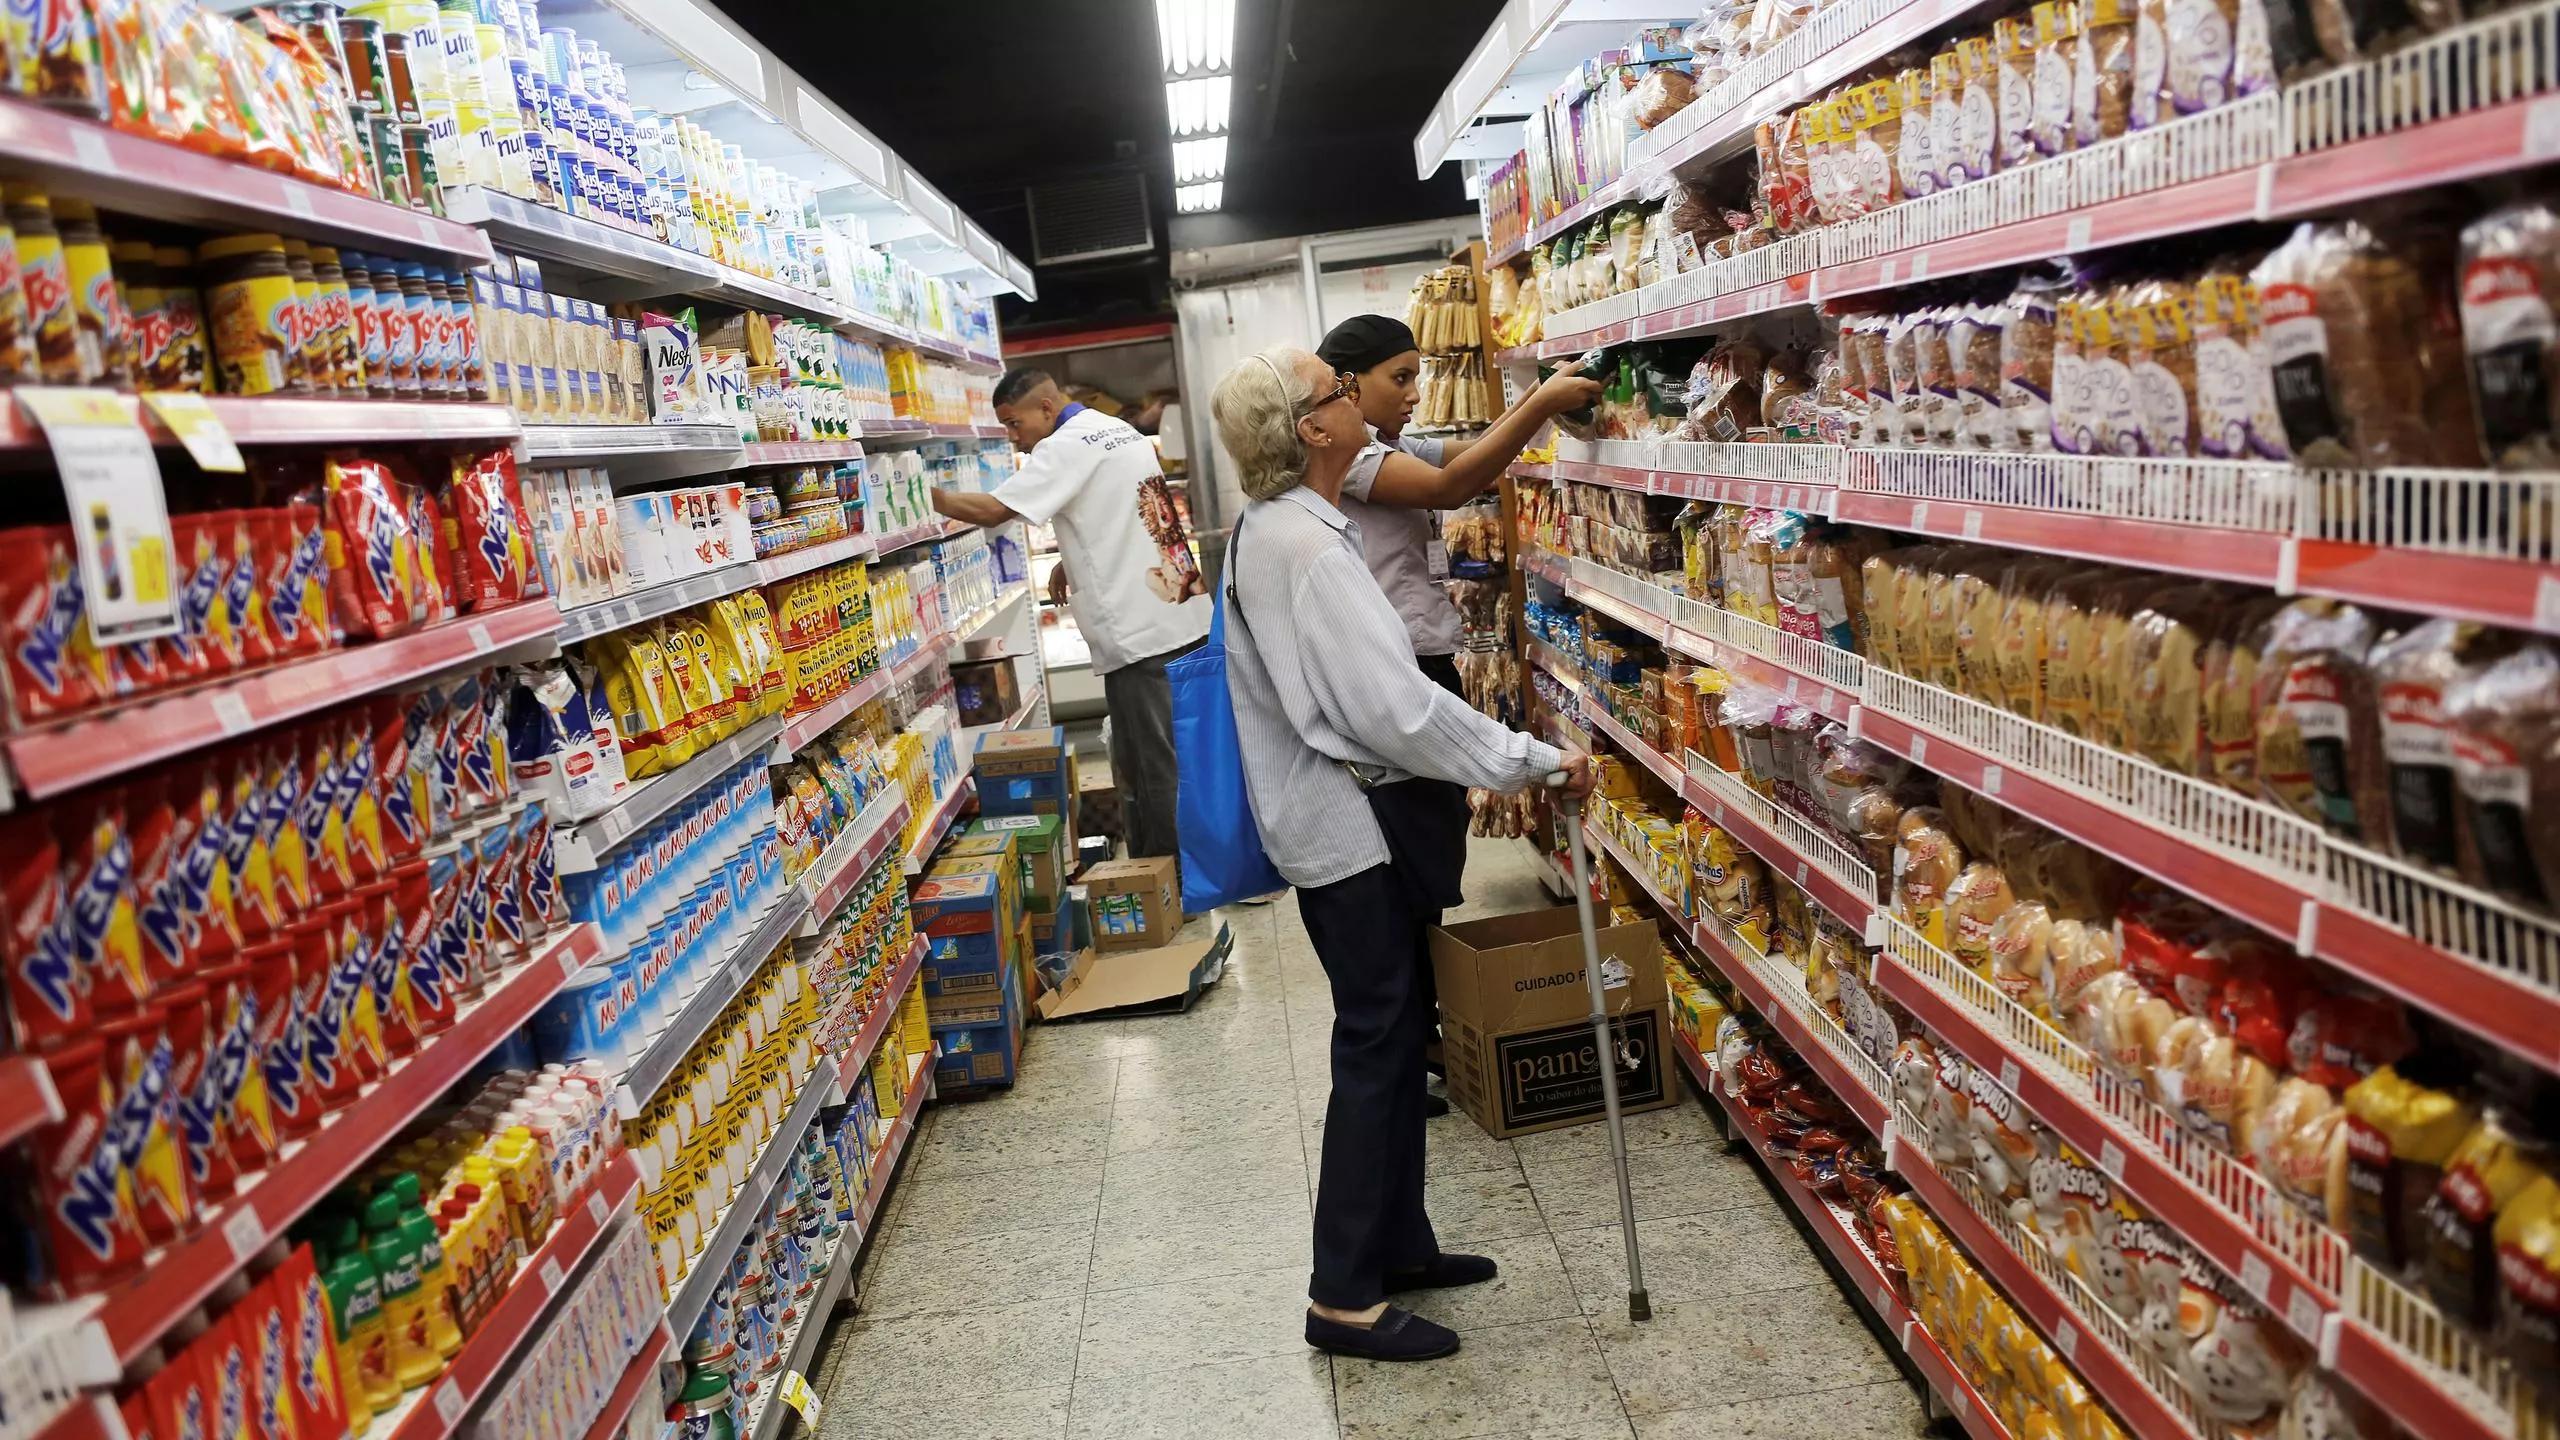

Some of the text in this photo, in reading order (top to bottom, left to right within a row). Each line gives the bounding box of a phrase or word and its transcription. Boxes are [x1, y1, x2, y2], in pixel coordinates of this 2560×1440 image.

[1514, 972, 1577, 993] CUIDADO
[1546, 1087, 1573, 1102] sabor
[1573, 1084, 1587, 1097] do
